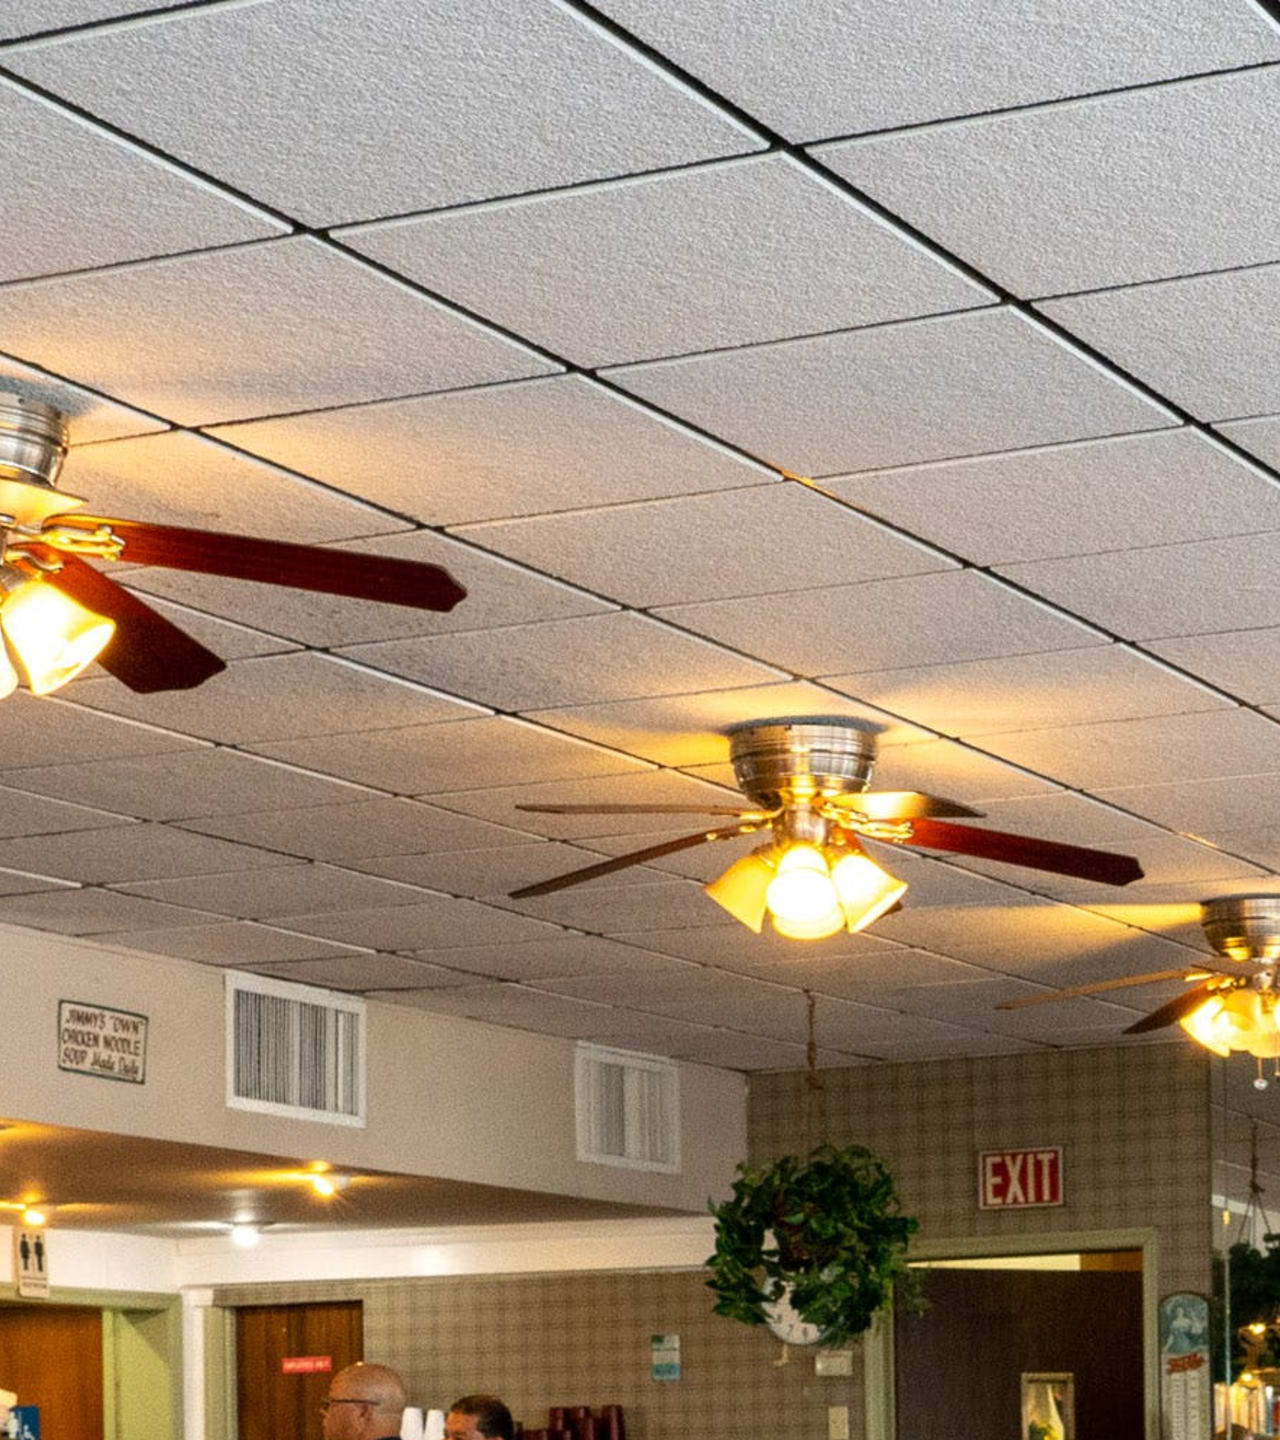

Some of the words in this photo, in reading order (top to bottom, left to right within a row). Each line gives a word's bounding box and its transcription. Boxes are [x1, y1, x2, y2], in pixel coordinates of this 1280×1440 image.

[62, 1028, 100, 1049] CHICKEN
[103, 1035, 142, 1057] NOODLE
[985, 1152, 1055, 1205] EXIT
